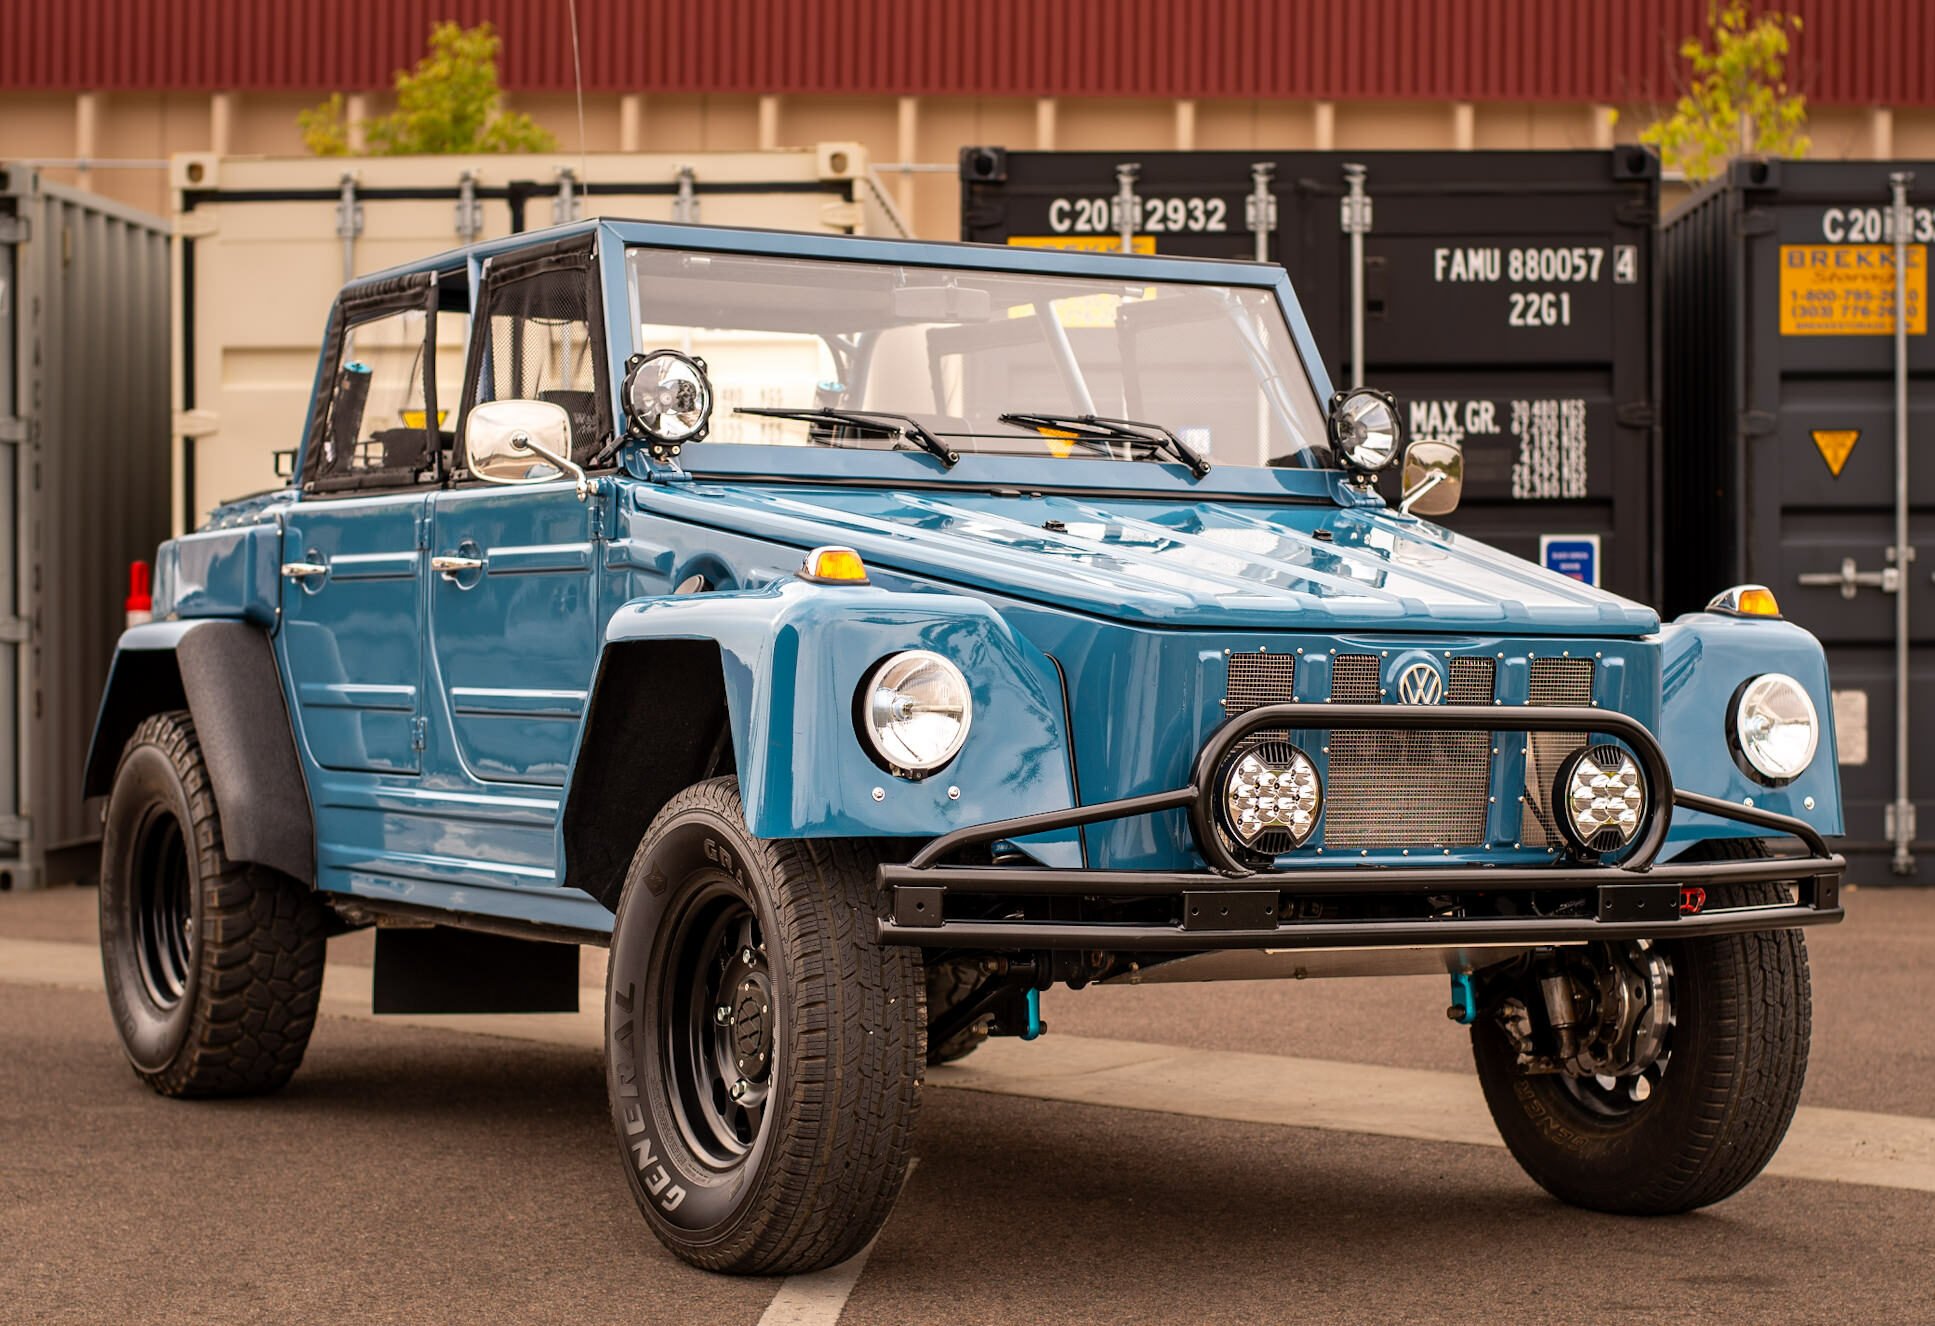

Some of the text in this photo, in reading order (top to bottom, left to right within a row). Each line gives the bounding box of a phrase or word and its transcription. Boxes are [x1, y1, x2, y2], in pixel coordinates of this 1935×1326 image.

[1435, 246, 1635, 282] FAMU 880057 4
[1509, 292, 1570, 326] 22G1
[614, 982, 687, 1212] GENERAL
